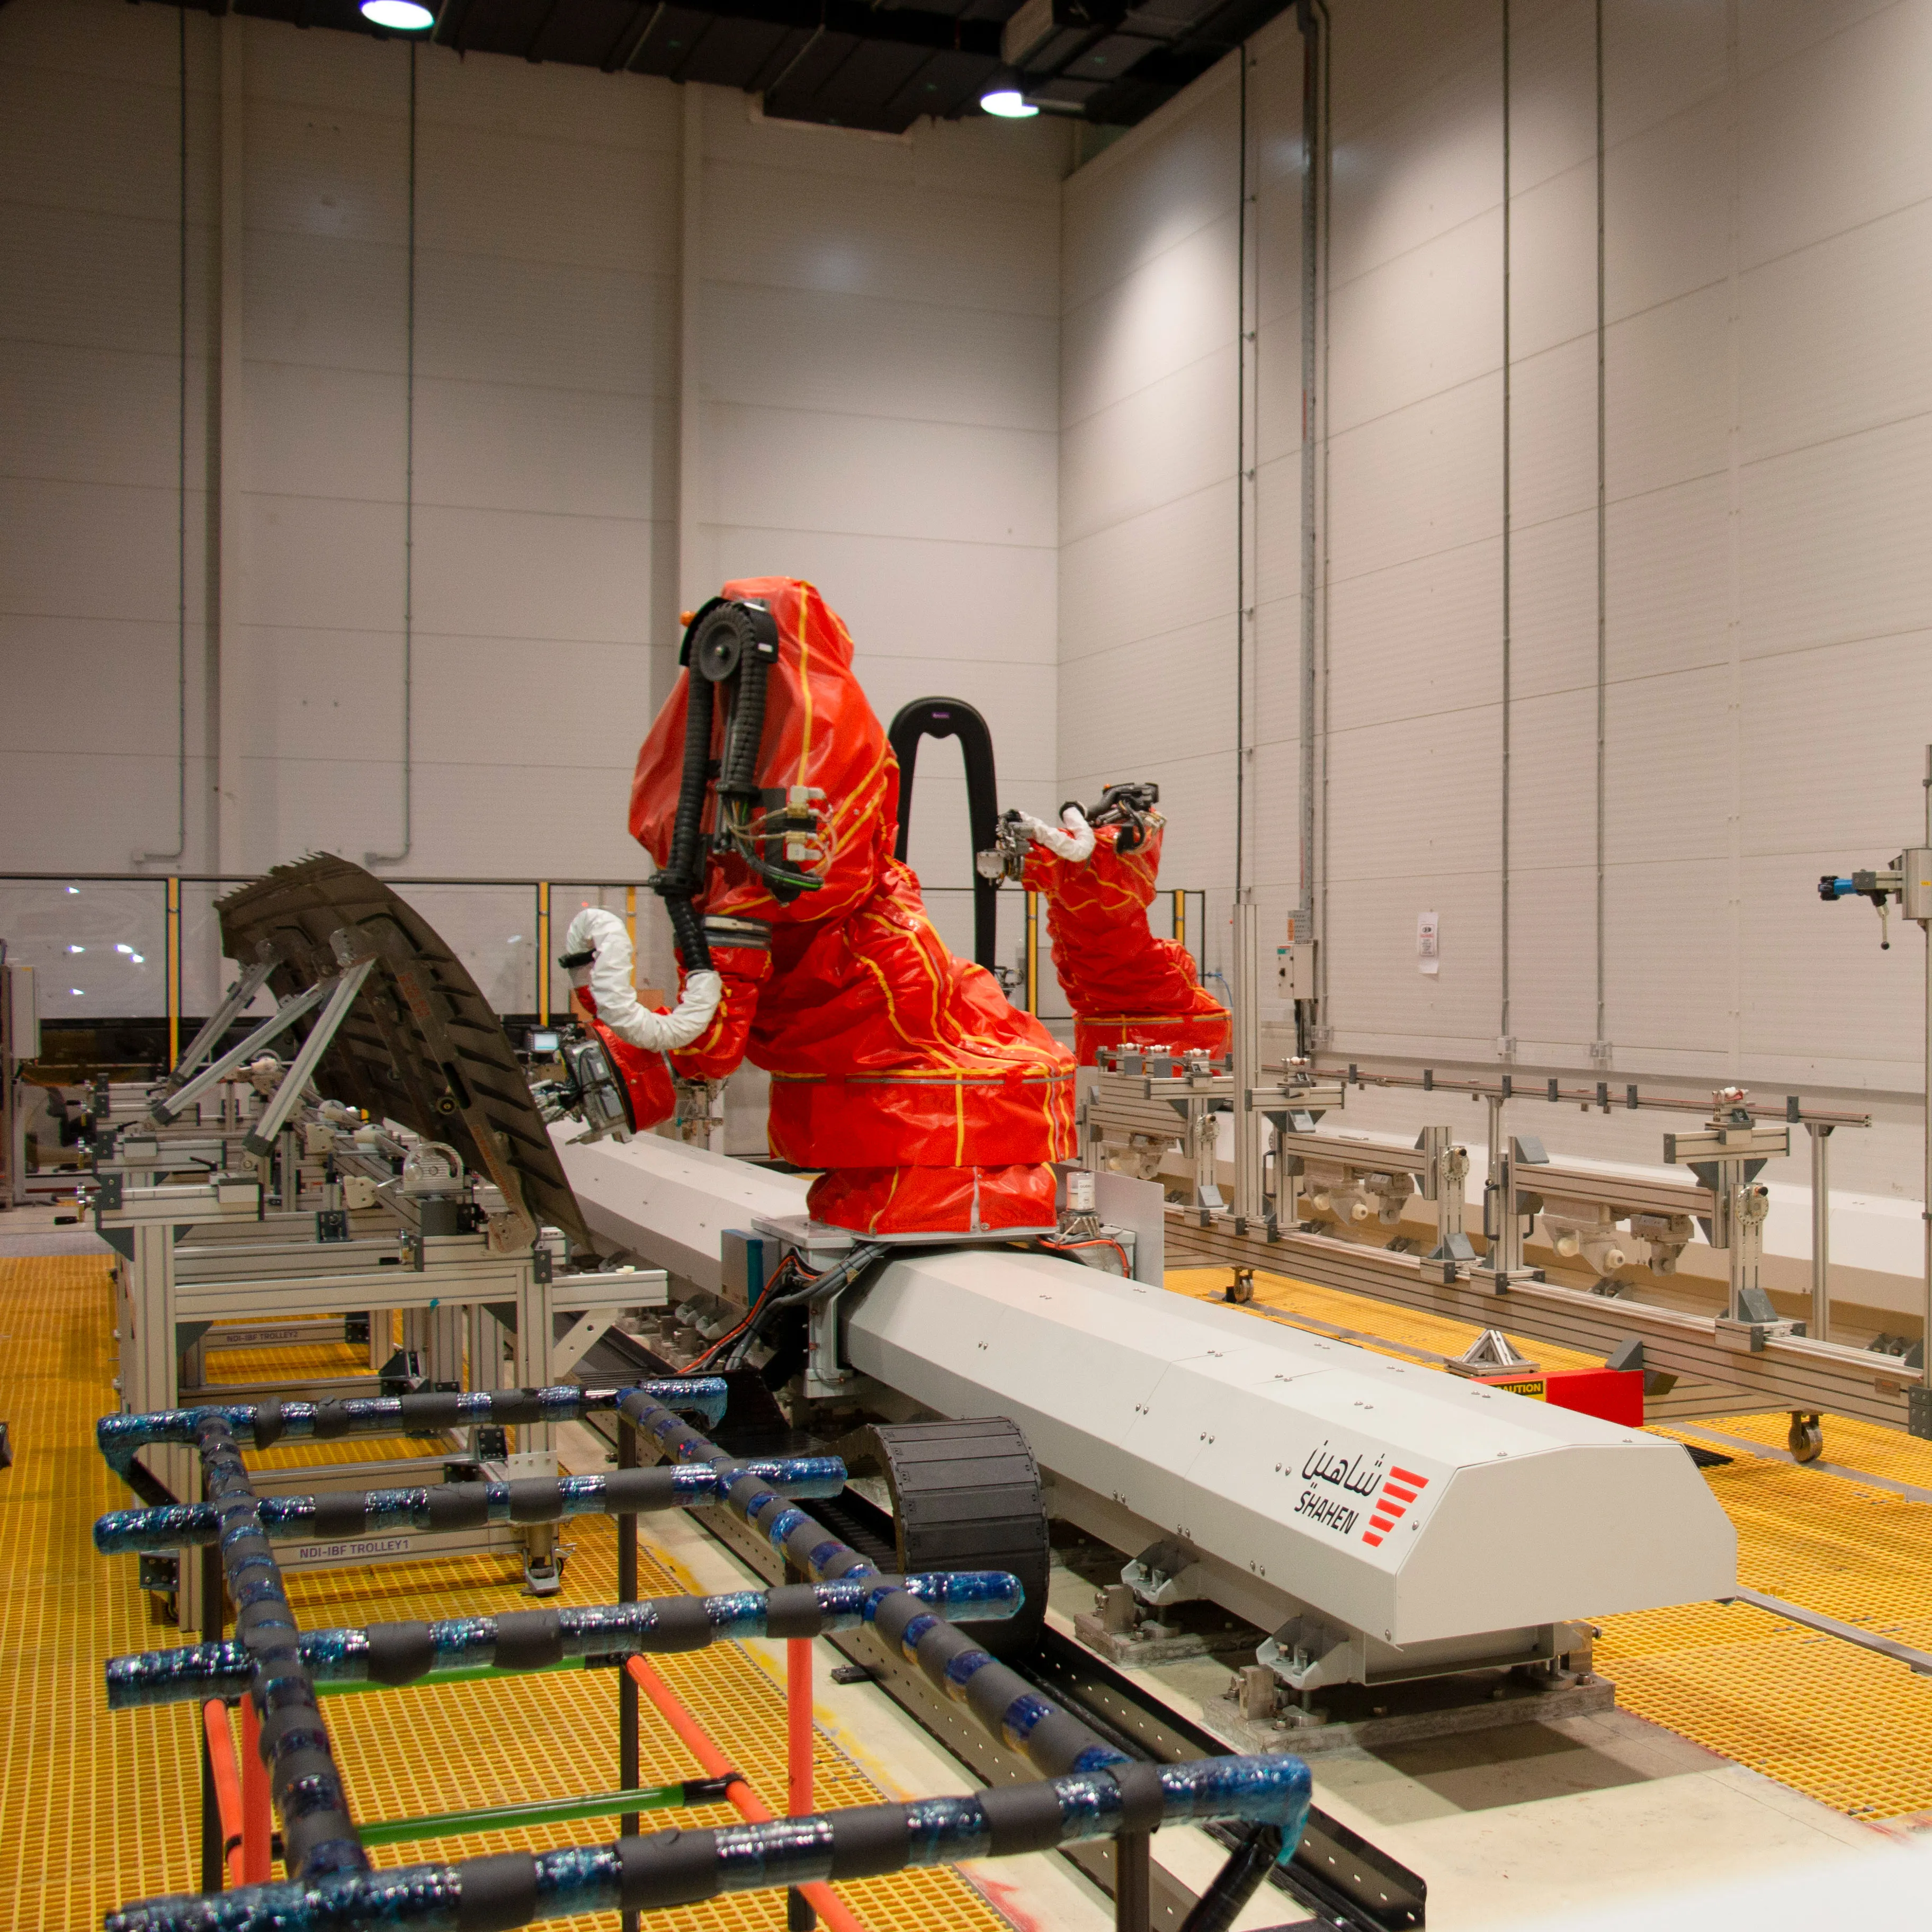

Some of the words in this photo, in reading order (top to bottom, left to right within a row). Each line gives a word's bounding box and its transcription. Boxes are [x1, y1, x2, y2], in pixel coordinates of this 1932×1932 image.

[227, 1334, 256, 1342] NDI-IBF
[260, 1330, 298, 1340] TROLLEY2
[1301, 1440, 1385, 1497] شاهين
[1294, 1490, 1359, 1534] SHAHEN
[300, 1545, 347, 1558] NDI-IBF
[350, 1539, 409, 1554] TROLLEY1
